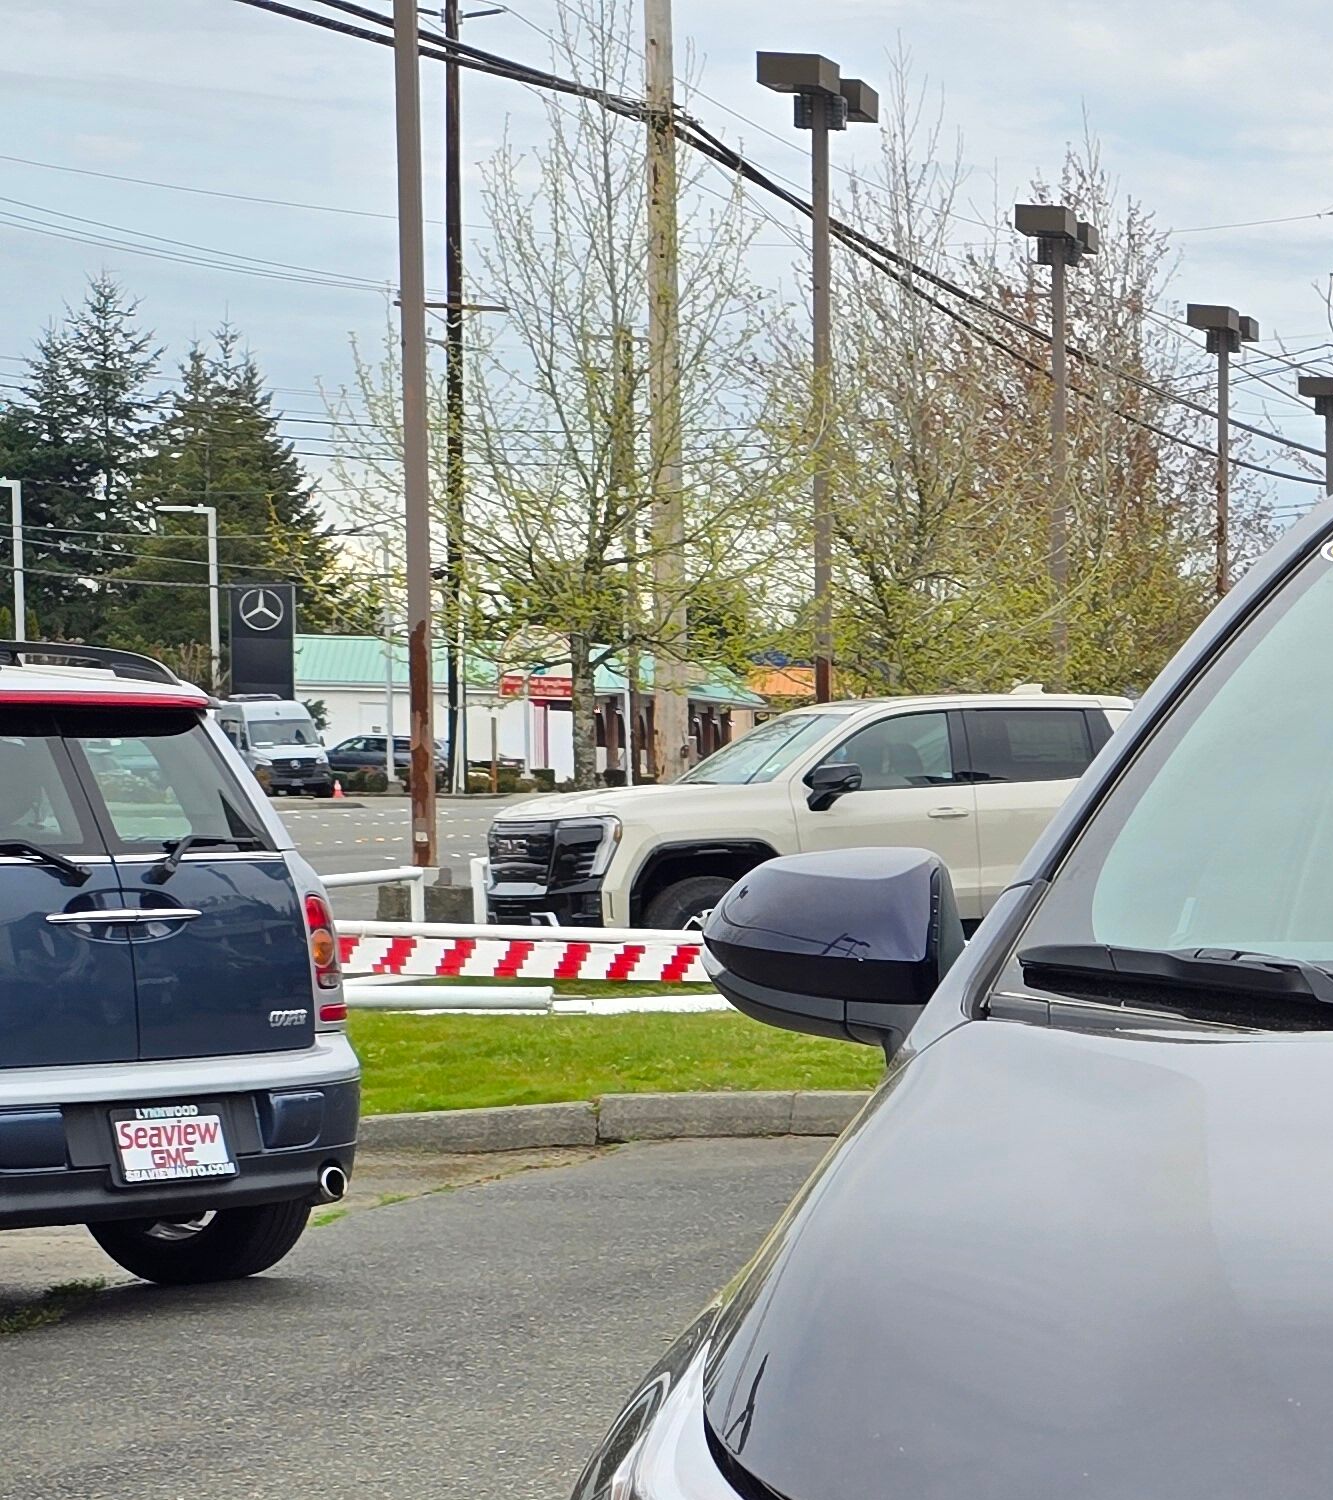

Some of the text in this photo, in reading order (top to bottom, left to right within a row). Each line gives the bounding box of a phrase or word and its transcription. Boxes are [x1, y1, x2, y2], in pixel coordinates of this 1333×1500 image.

[135, 1105, 198, 1119] LYNNWOOD
[118, 1120, 219, 1150] Seaview
[151, 1147, 199, 1168] GMC
